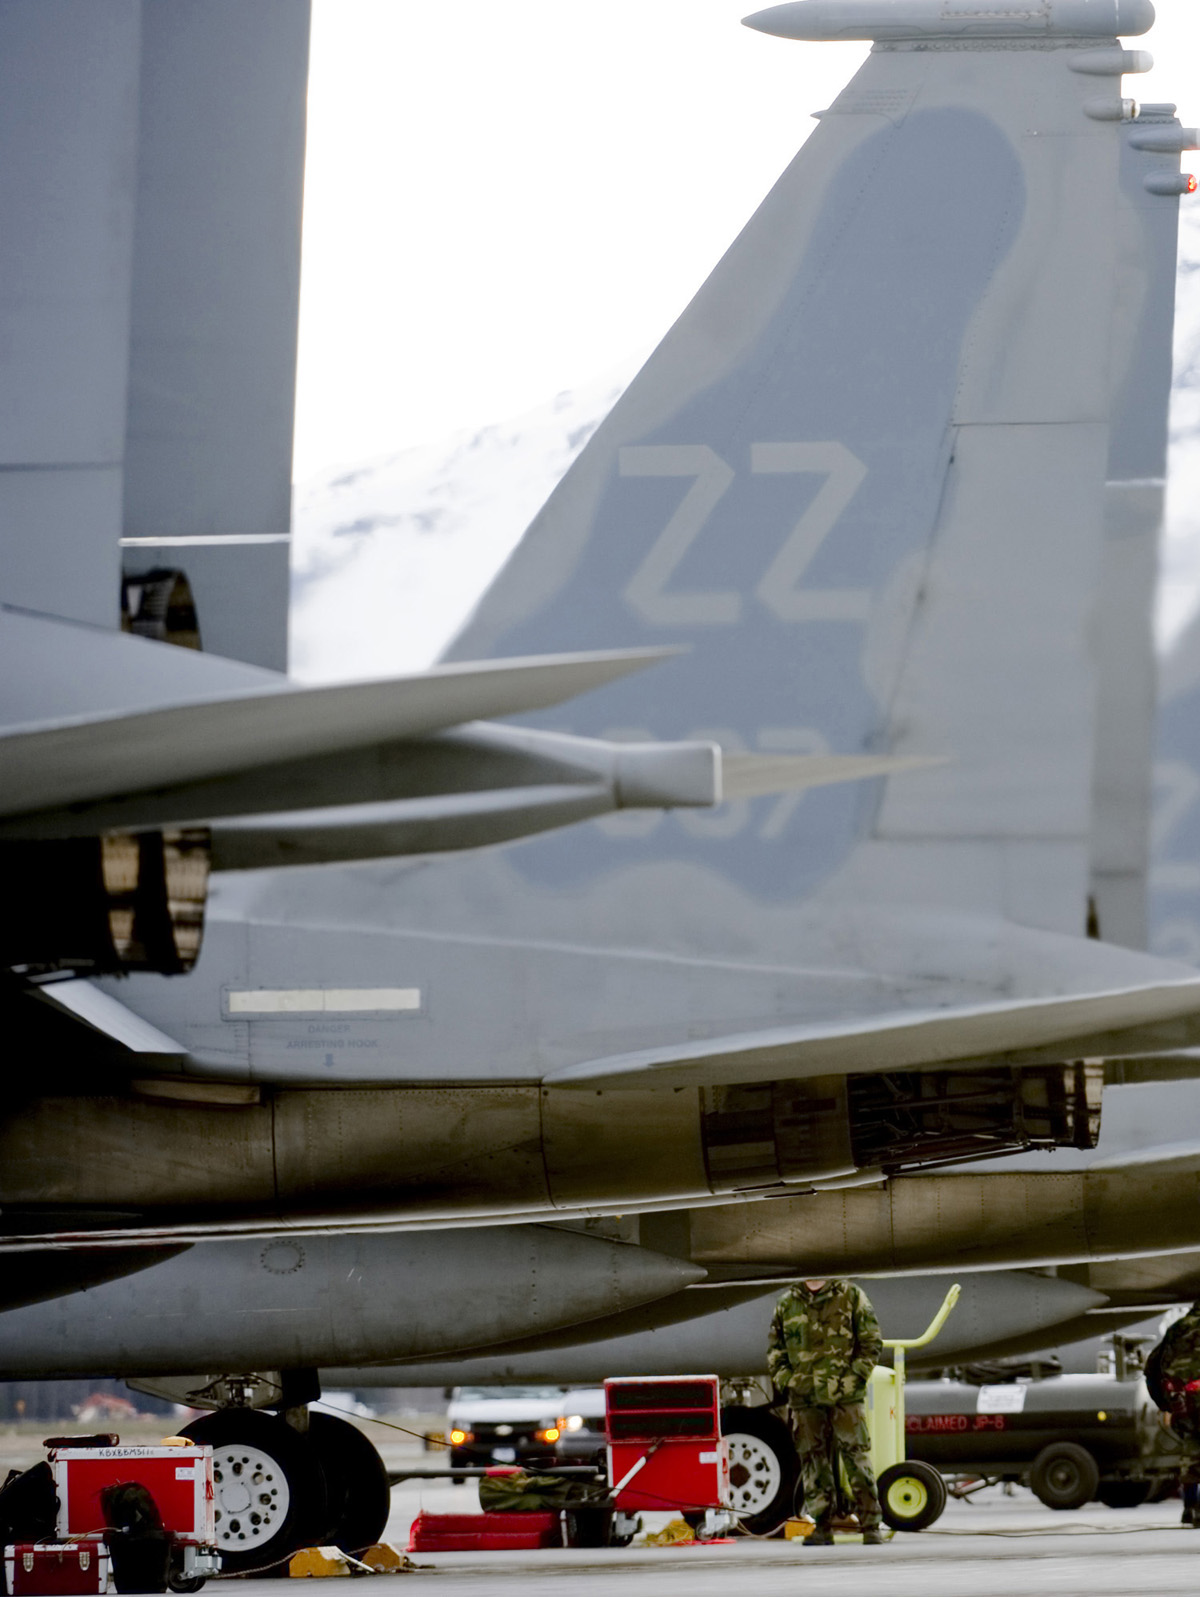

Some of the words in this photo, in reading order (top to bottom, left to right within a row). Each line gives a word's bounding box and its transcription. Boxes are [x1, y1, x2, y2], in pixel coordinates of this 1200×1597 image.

[618, 440, 874, 626] ZZ
[307, 1024, 351, 1033] DANGER
[286, 1039, 345, 1050] ARRESTING
[347, 1039, 379, 1049] HOOK
